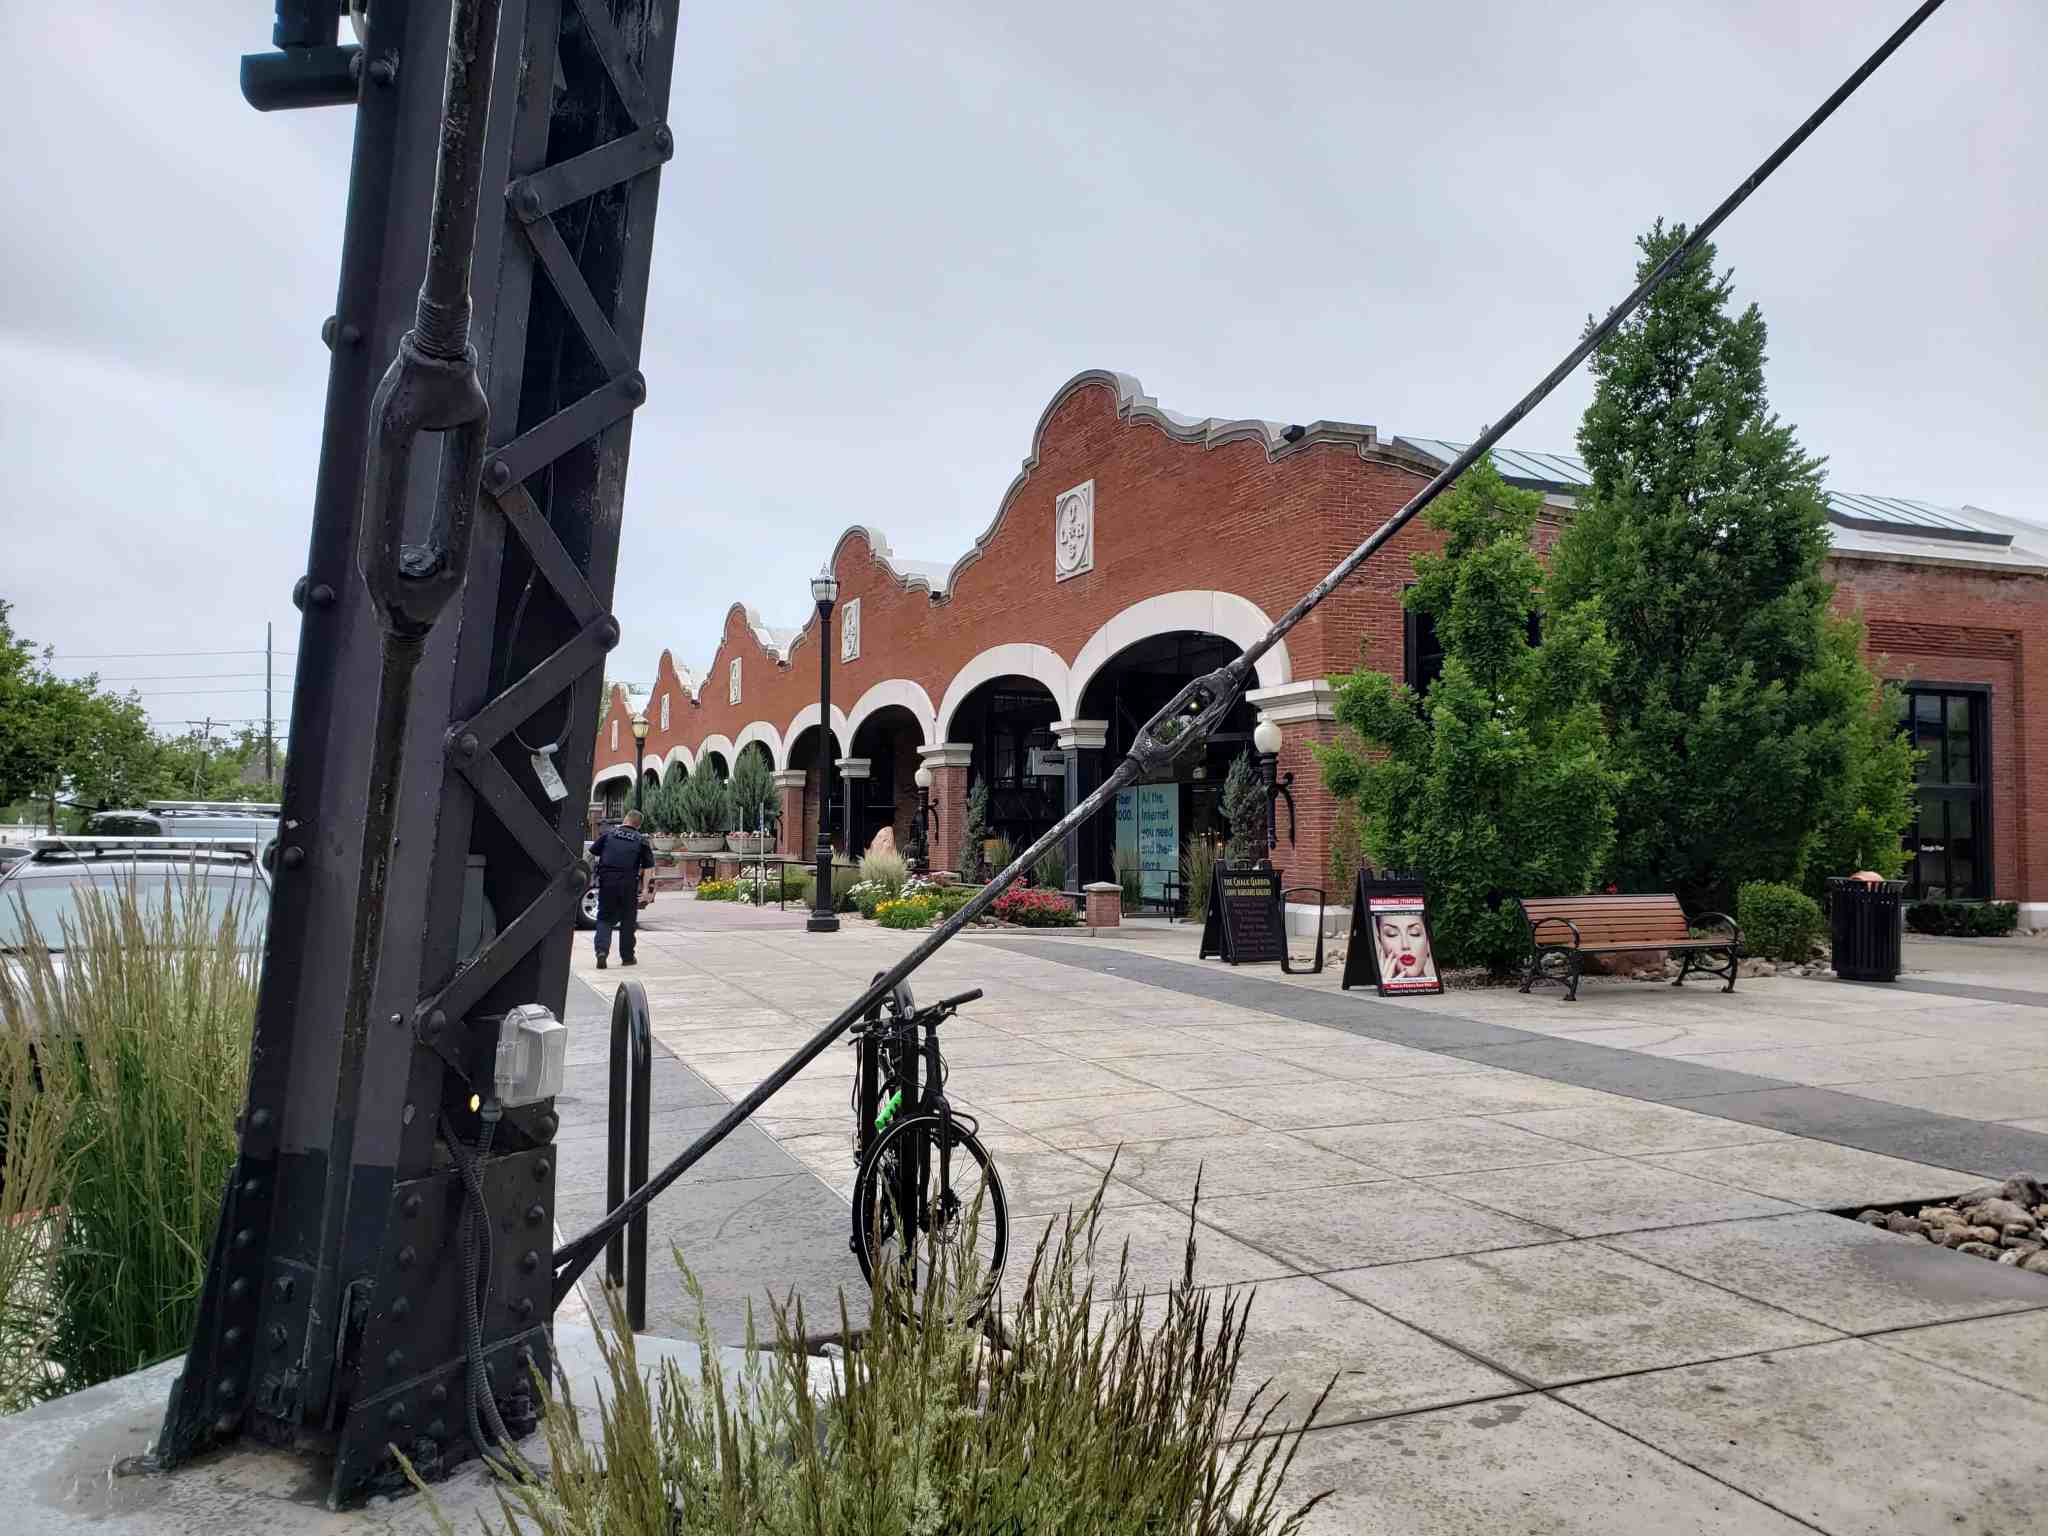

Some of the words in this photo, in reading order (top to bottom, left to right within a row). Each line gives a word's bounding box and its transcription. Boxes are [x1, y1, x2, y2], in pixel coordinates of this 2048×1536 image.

[1152, 791, 1164, 803] the
[1142, 807, 1169, 820] Internet
[614, 829, 640, 841] POLICE
[1156, 825, 1174, 838] need
